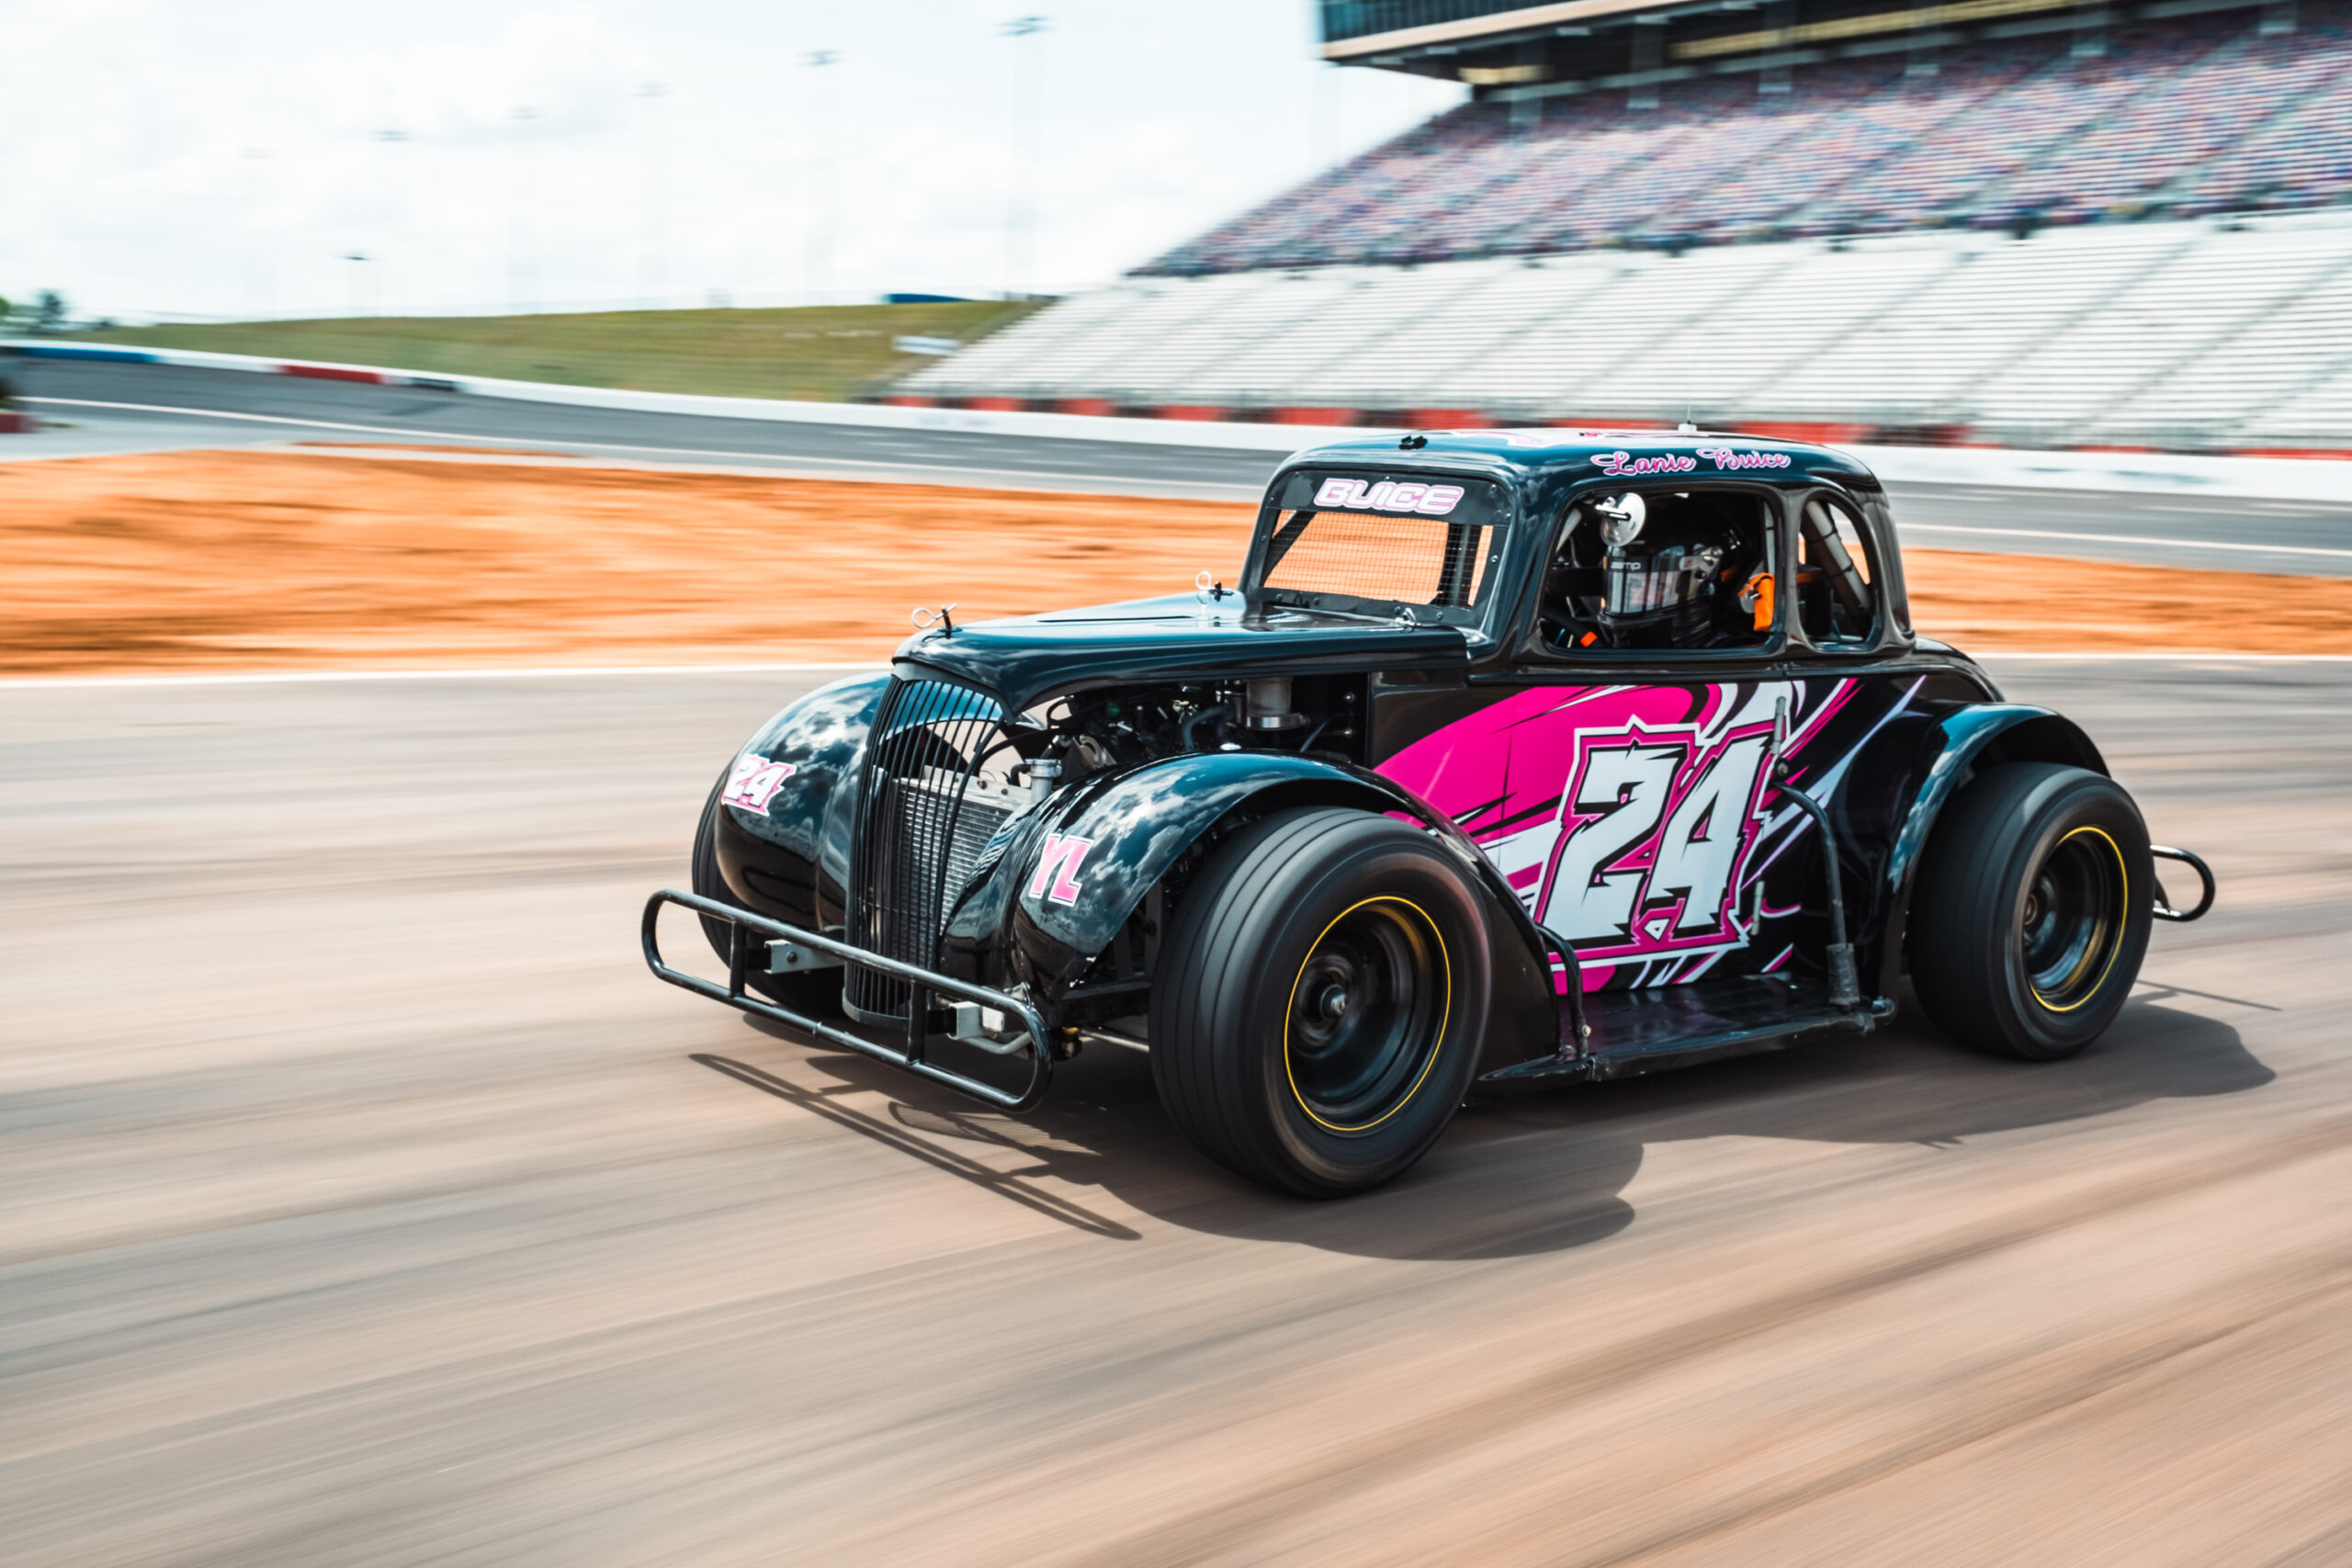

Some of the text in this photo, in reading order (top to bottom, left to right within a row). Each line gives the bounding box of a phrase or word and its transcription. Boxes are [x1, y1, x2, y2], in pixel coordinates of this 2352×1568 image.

[1590, 447, 1791, 476] Lanie Buice
[1315, 479, 1464, 514] BUICE
[723, 755, 793, 811] 24
[1541, 735, 1771, 943] 24
[1028, 833, 1093, 907] YL
